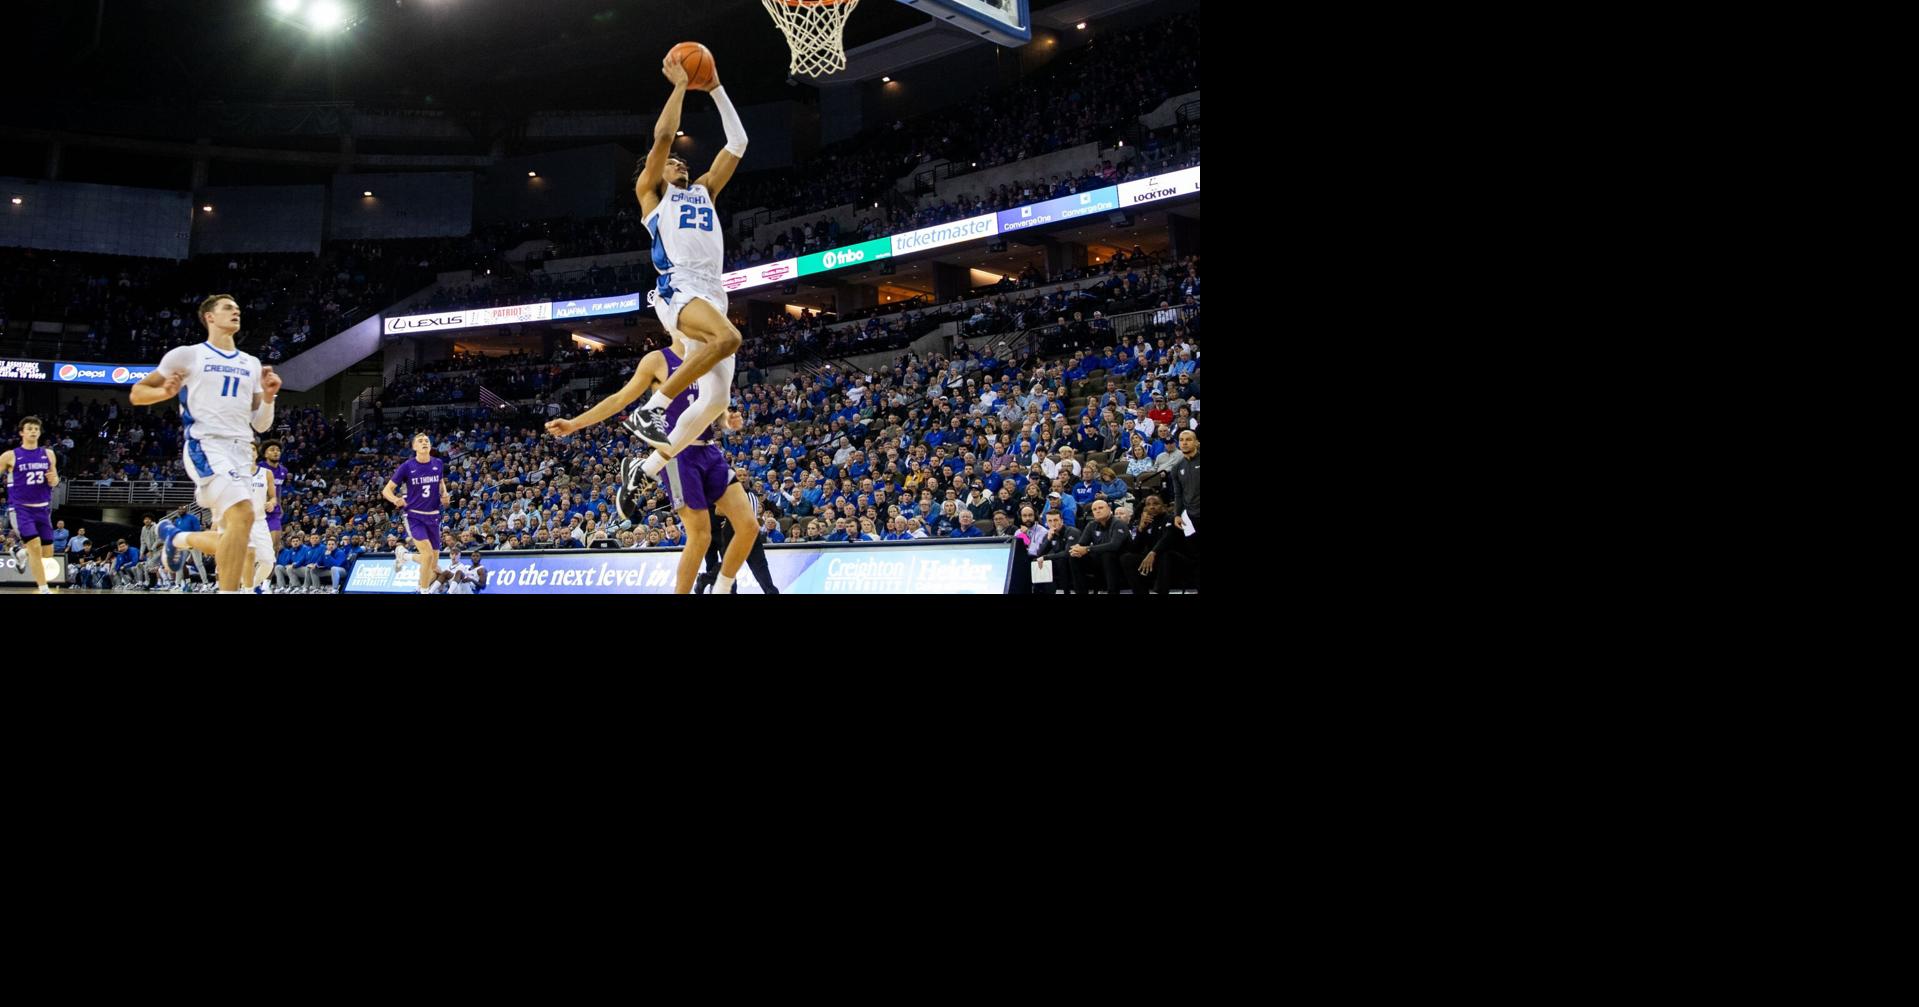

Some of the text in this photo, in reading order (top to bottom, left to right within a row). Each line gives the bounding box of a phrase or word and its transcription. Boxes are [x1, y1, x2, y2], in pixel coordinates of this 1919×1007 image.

[1133, 187, 1176, 203] LOCKTON
[1061, 202, 1112, 217] ConvergeOne
[679, 204, 714, 232] 23
[1003, 215, 1052, 231] ConvergeOne
[896, 218, 992, 250] ticketmaster
[836, 249, 864, 264] fnbo
[408, 316, 463, 328] LEXUS
[77, 370, 106, 379] pepsi
[203, 364, 250, 377] CREIGHTON
[220, 375, 241, 398] 11
[26, 471, 45, 485] 23
[421, 484, 431, 498] 3
[496, 568, 516, 586] to
[518, 561, 549, 587] the
[549, 567, 597, 587] next
[597, 562, 648, 587] level
[647, 562, 672, 588] in
[827, 556, 904, 581] Creighton
[917, 557, 993, 581] Heider
